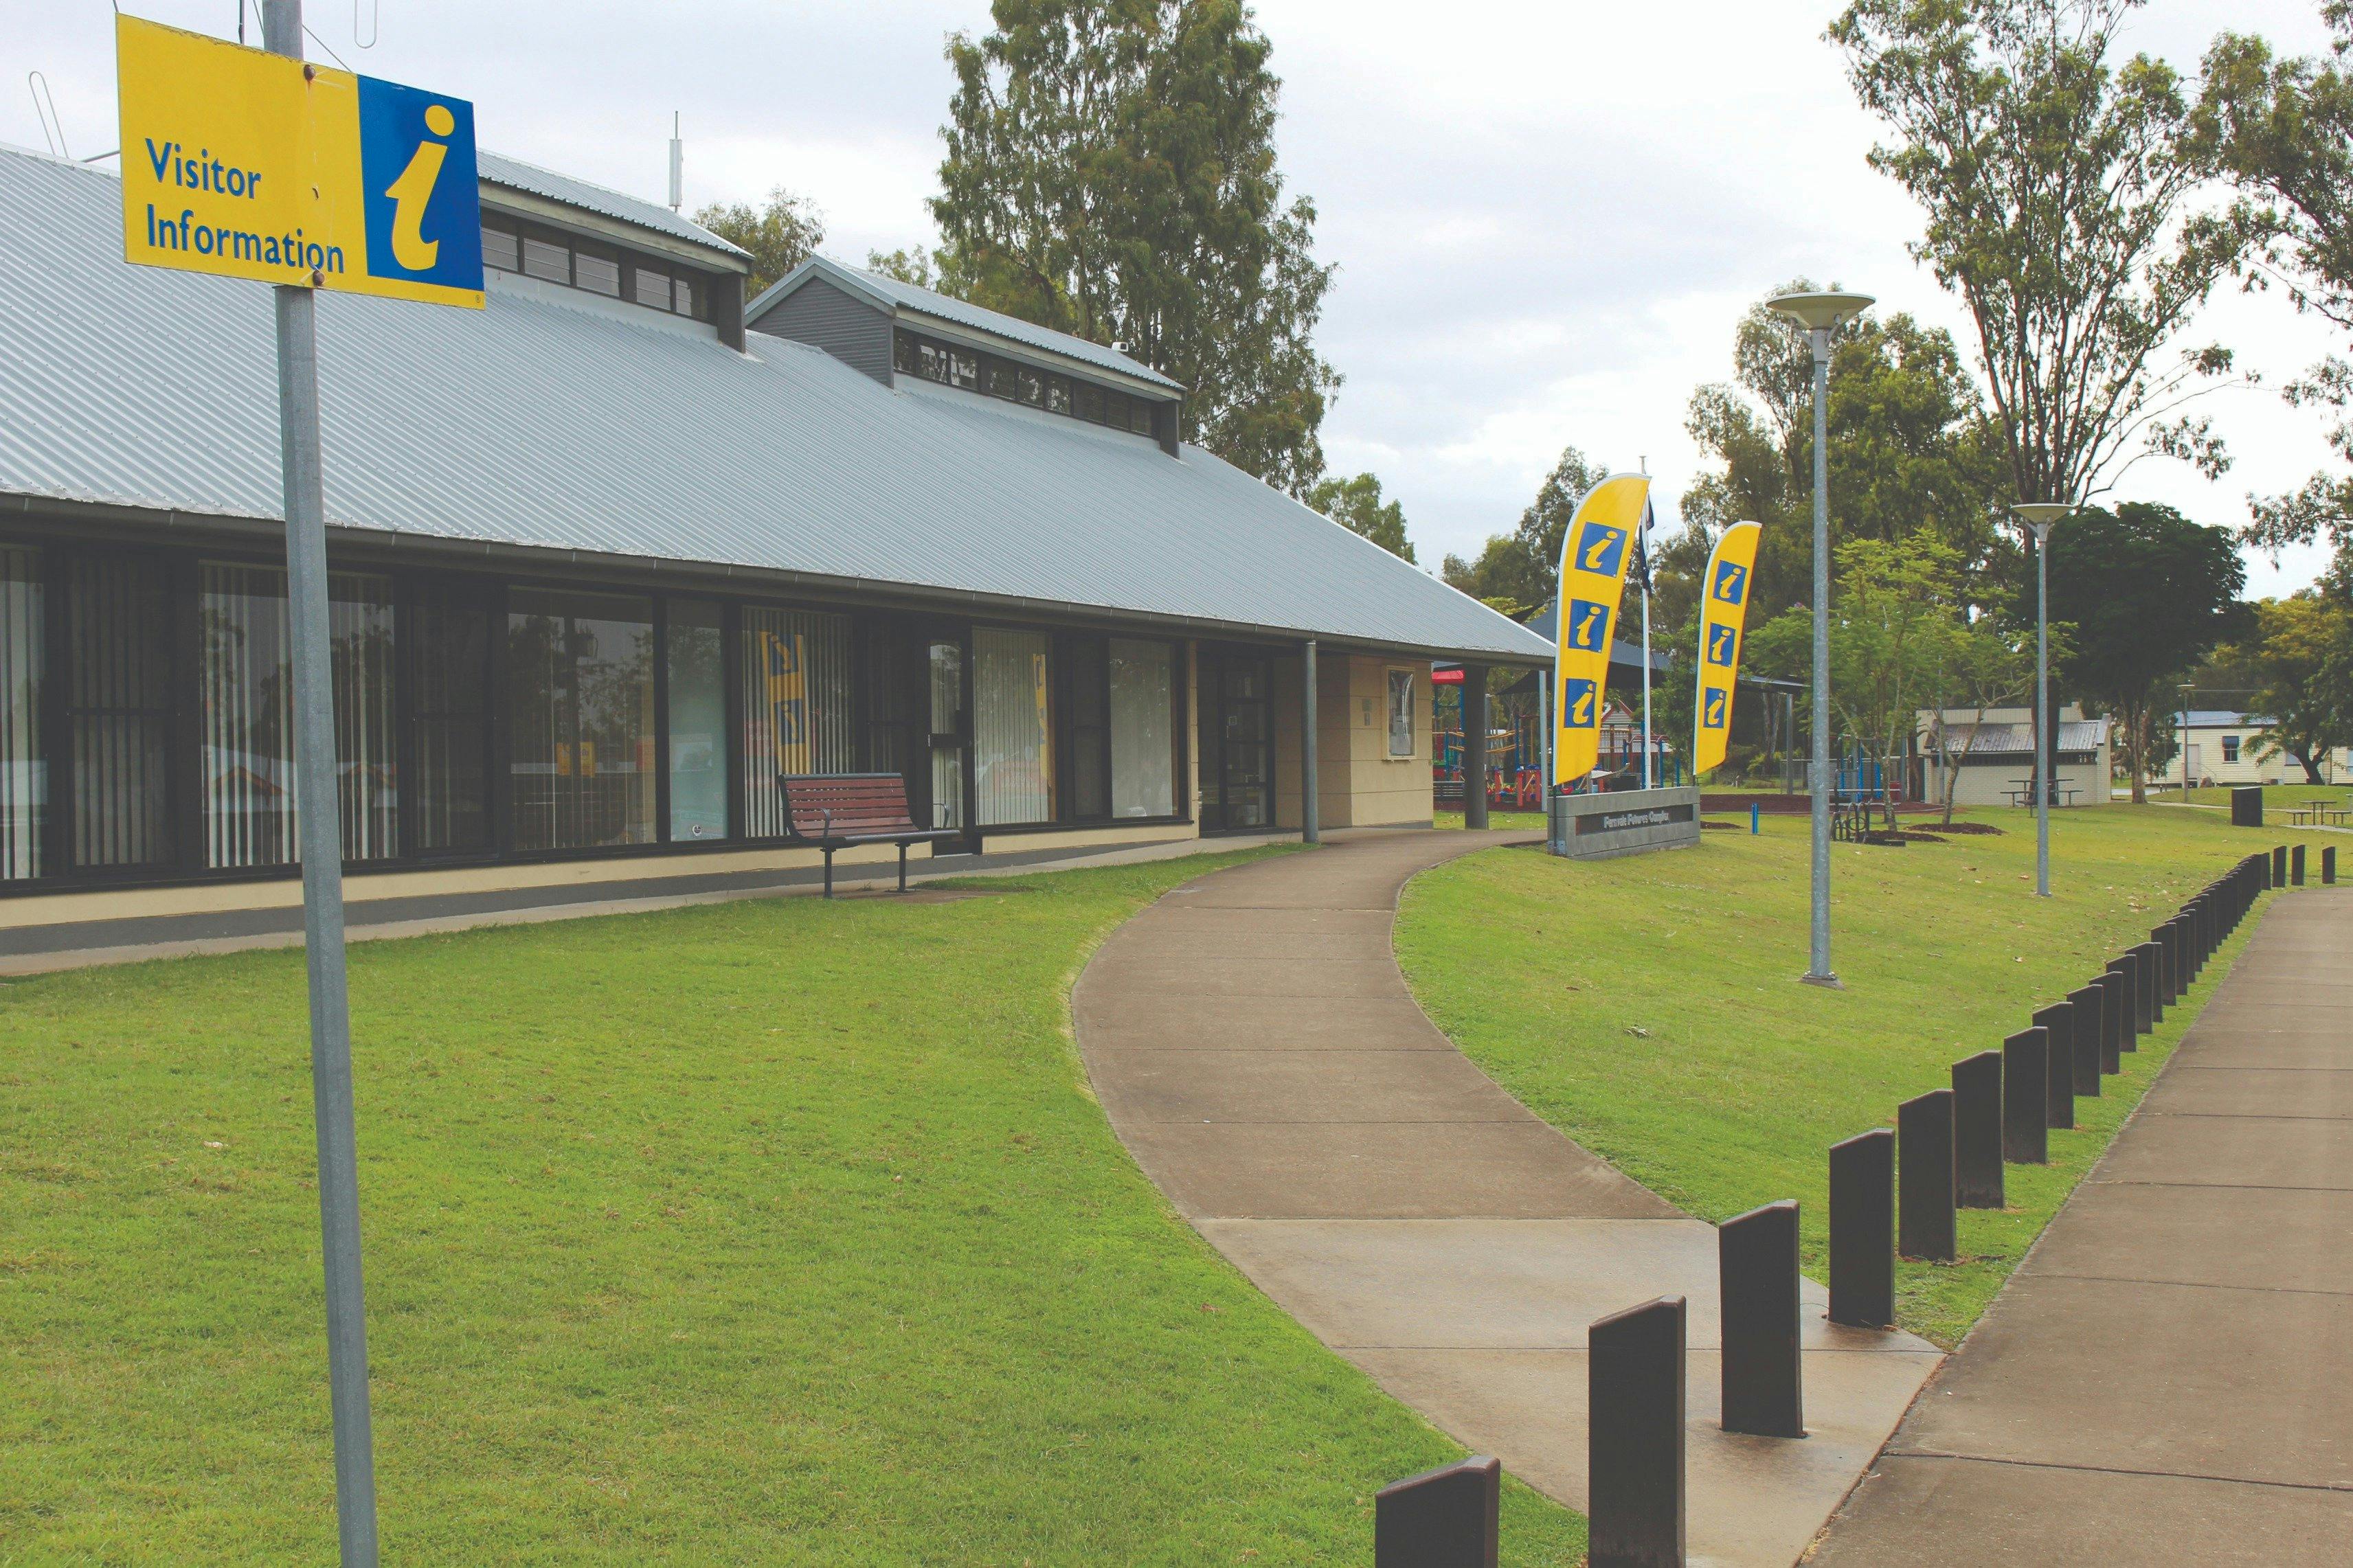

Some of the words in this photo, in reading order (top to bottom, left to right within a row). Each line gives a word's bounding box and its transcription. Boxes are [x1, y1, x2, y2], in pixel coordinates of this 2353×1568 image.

[145, 137, 262, 199] Visitor
[385, 104, 455, 271] i
[147, 203, 344, 274] Information
